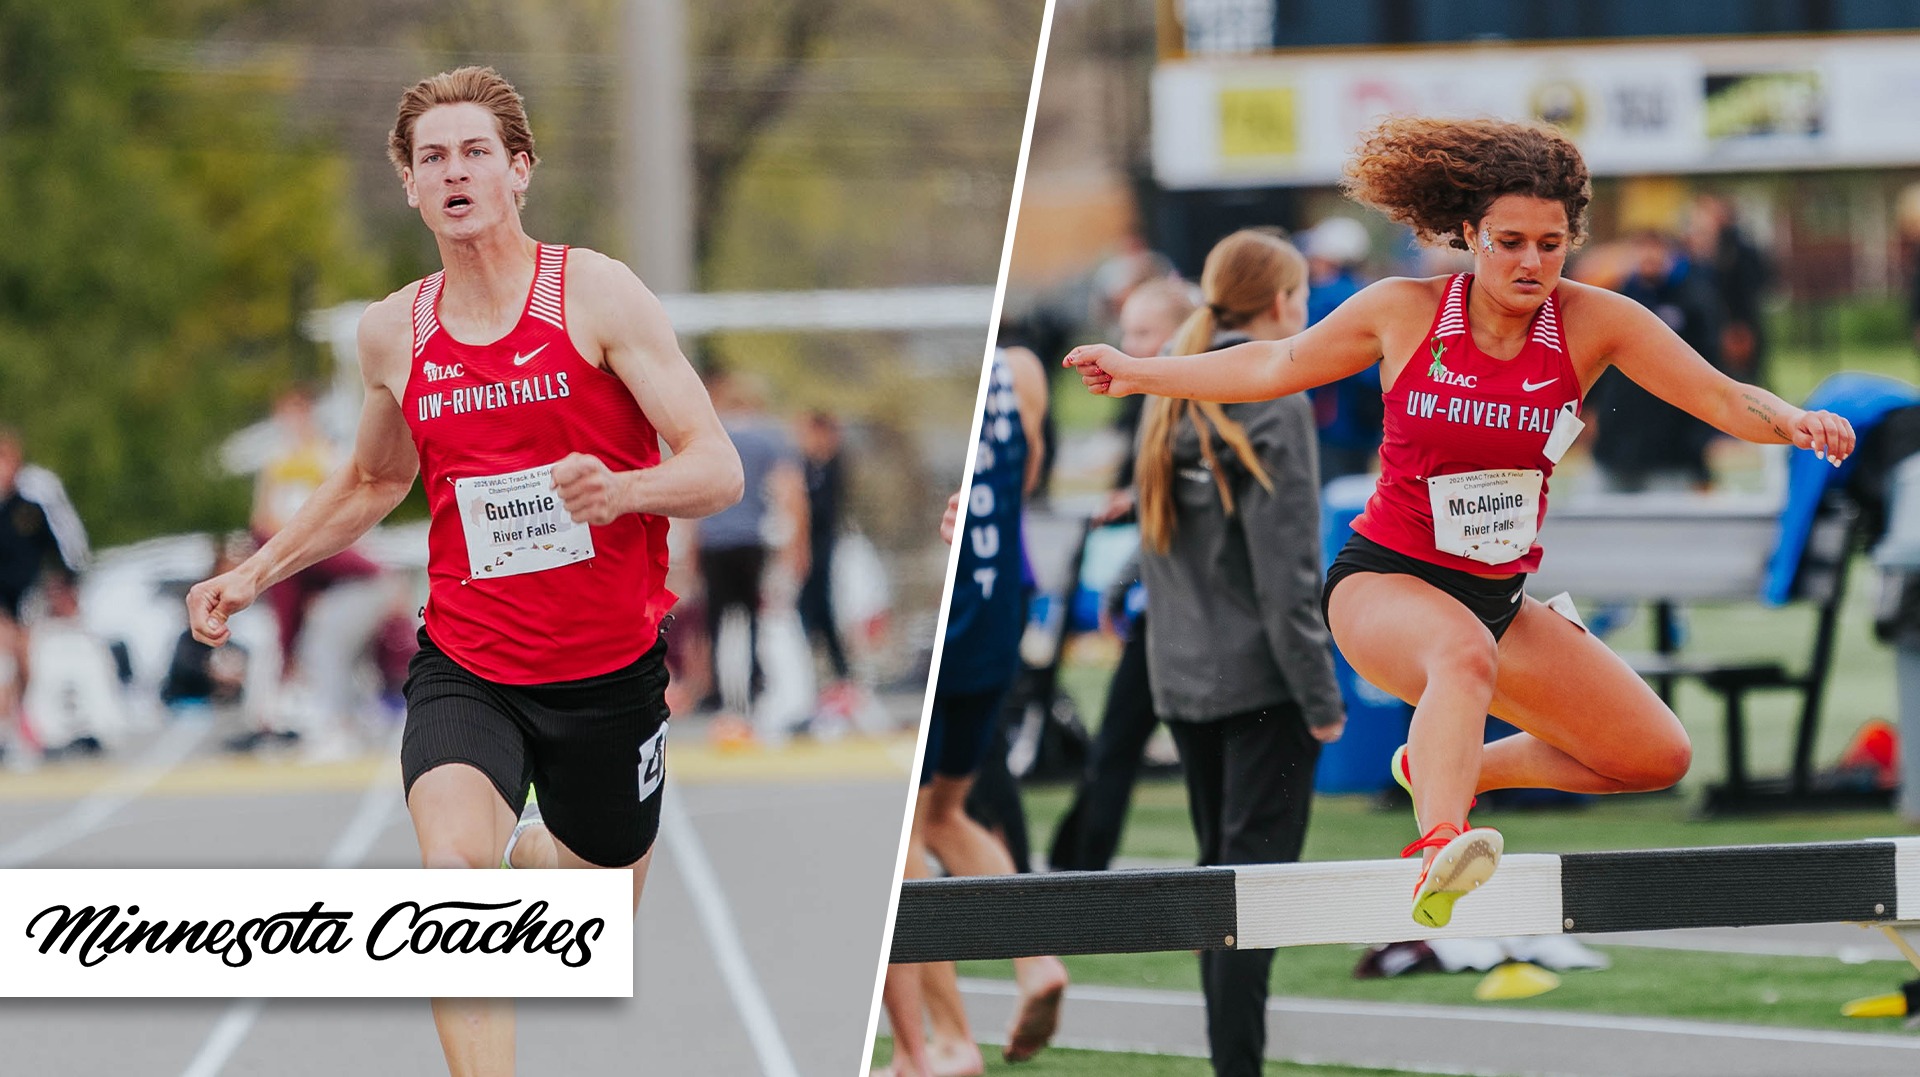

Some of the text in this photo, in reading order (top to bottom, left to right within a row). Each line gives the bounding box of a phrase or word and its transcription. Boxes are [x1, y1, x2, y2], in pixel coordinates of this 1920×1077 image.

[427, 363, 465, 382] WIAC
[418, 372, 570, 421] UW-RIVER FALLS
[1407, 390, 1511, 429] UW-RIVER
[489, 478, 507, 486] WIAC
[508, 474, 527, 483] Track
[489, 481, 541, 494] Championships
[1464, 480, 1508, 490] Championships
[485, 494, 554, 521] Guthrie
[1449, 492, 1523, 516] McAlpine
[493, 523, 557, 543] River Falls
[1464, 520, 1514, 536] River Falls
[644, 733, 663, 784] 4
